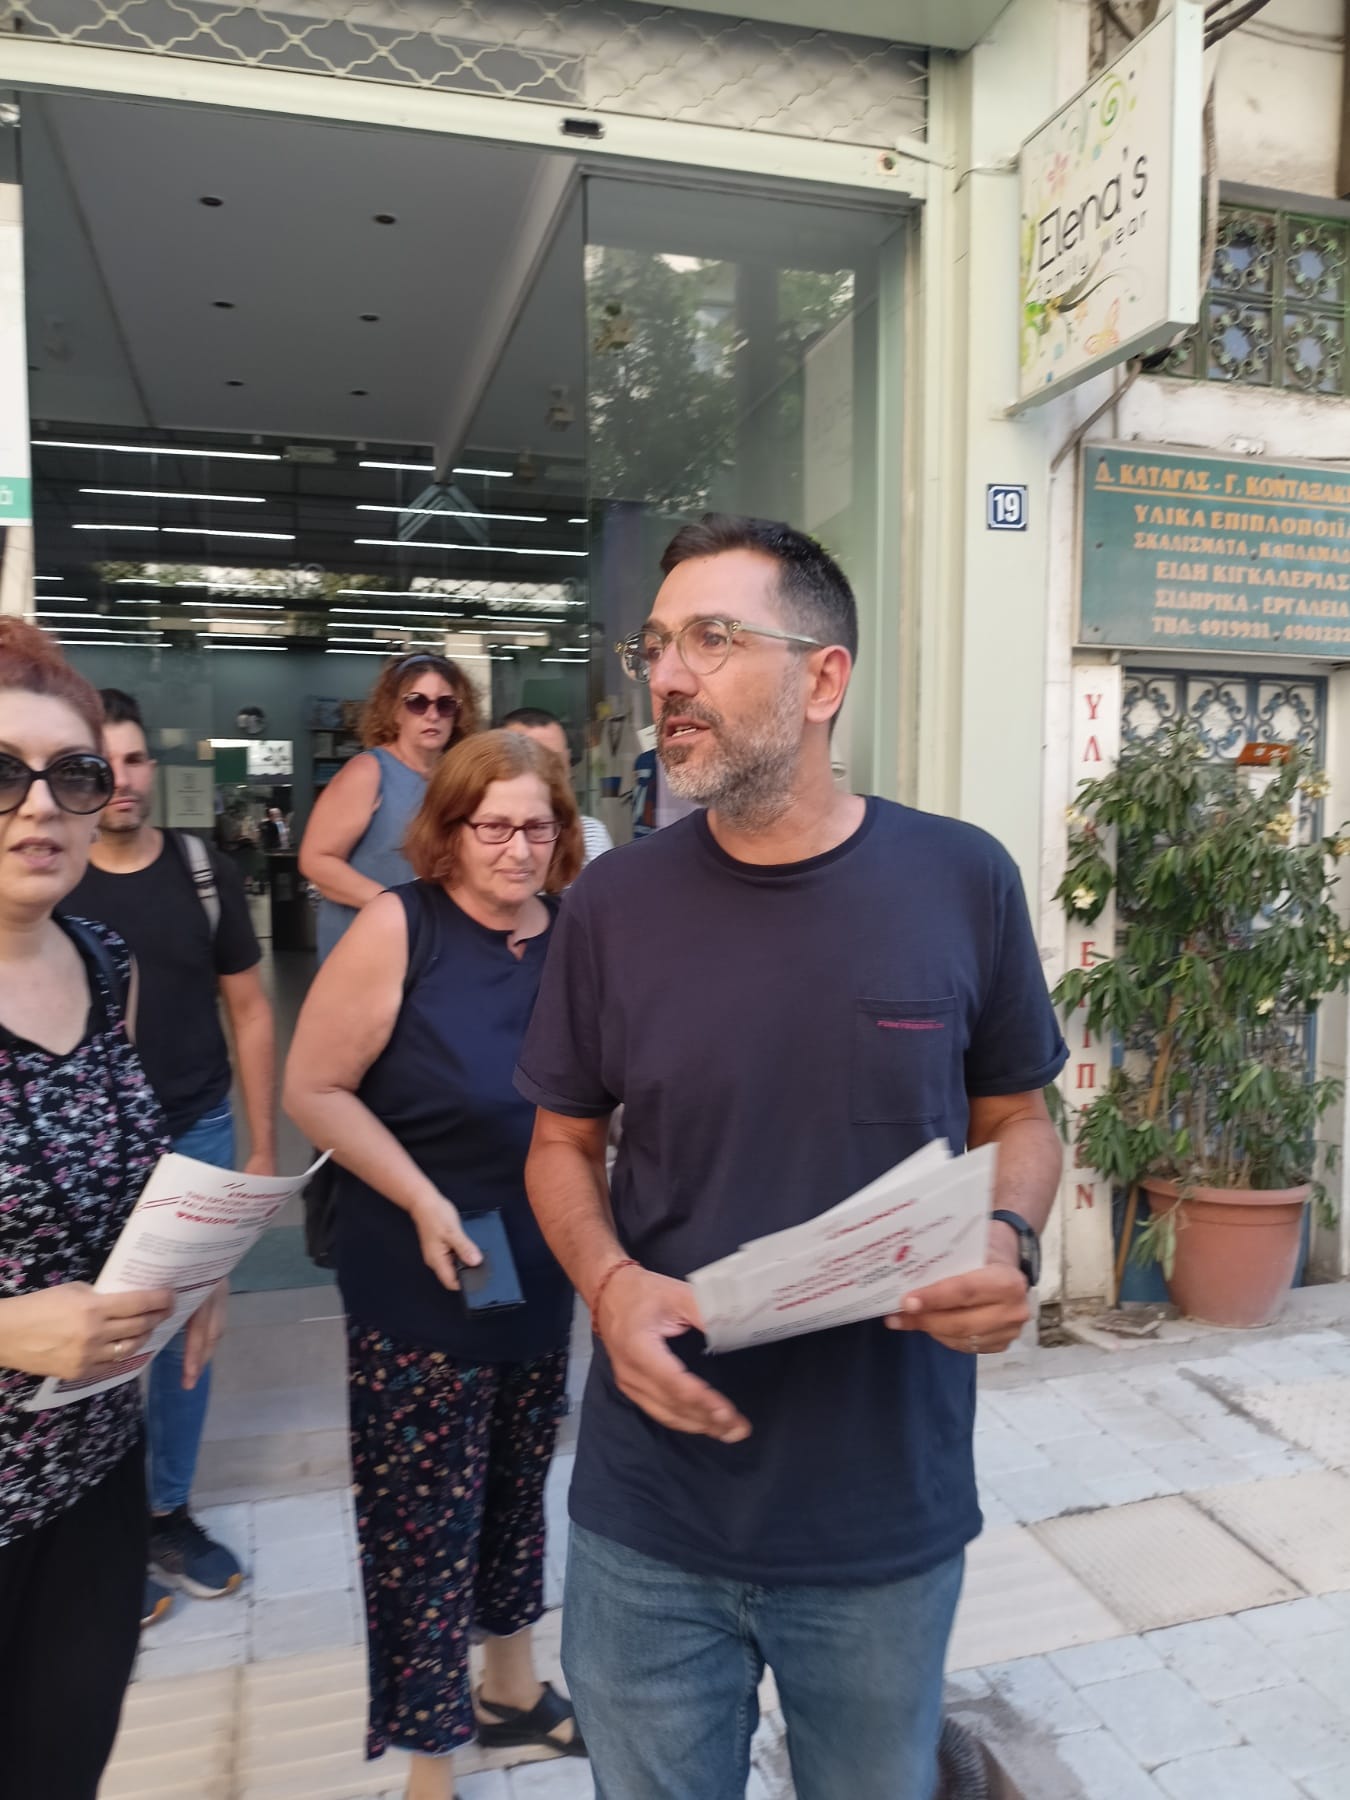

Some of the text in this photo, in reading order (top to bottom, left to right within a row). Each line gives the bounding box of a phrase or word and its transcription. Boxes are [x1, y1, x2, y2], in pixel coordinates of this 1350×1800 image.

[1038, 146, 1149, 272] Elena's
[1099, 208, 1147, 254] wear
[1095, 461, 1115, 483] Δ.
[1120, 464, 1210, 491] ΚΑΤΑΓΑΣ
[1225, 473, 1242, 495] Γ.
[1246, 475, 1350, 504] ΚΟΝΤΑΞΑΚ
[993, 491, 1020, 522] 19
[1134, 504, 1206, 528] ΥΛΙΚΑ
[1156, 561, 1350, 591] ΕΙΔΗ ΚΙΓΚΑΛΕΡΙΑΣ
[1155, 589, 1248, 612] ΣΙΔΗΡΙΚΑ
[1263, 596, 1350, 618] ΕΡΓΑΛΕΙΑ
